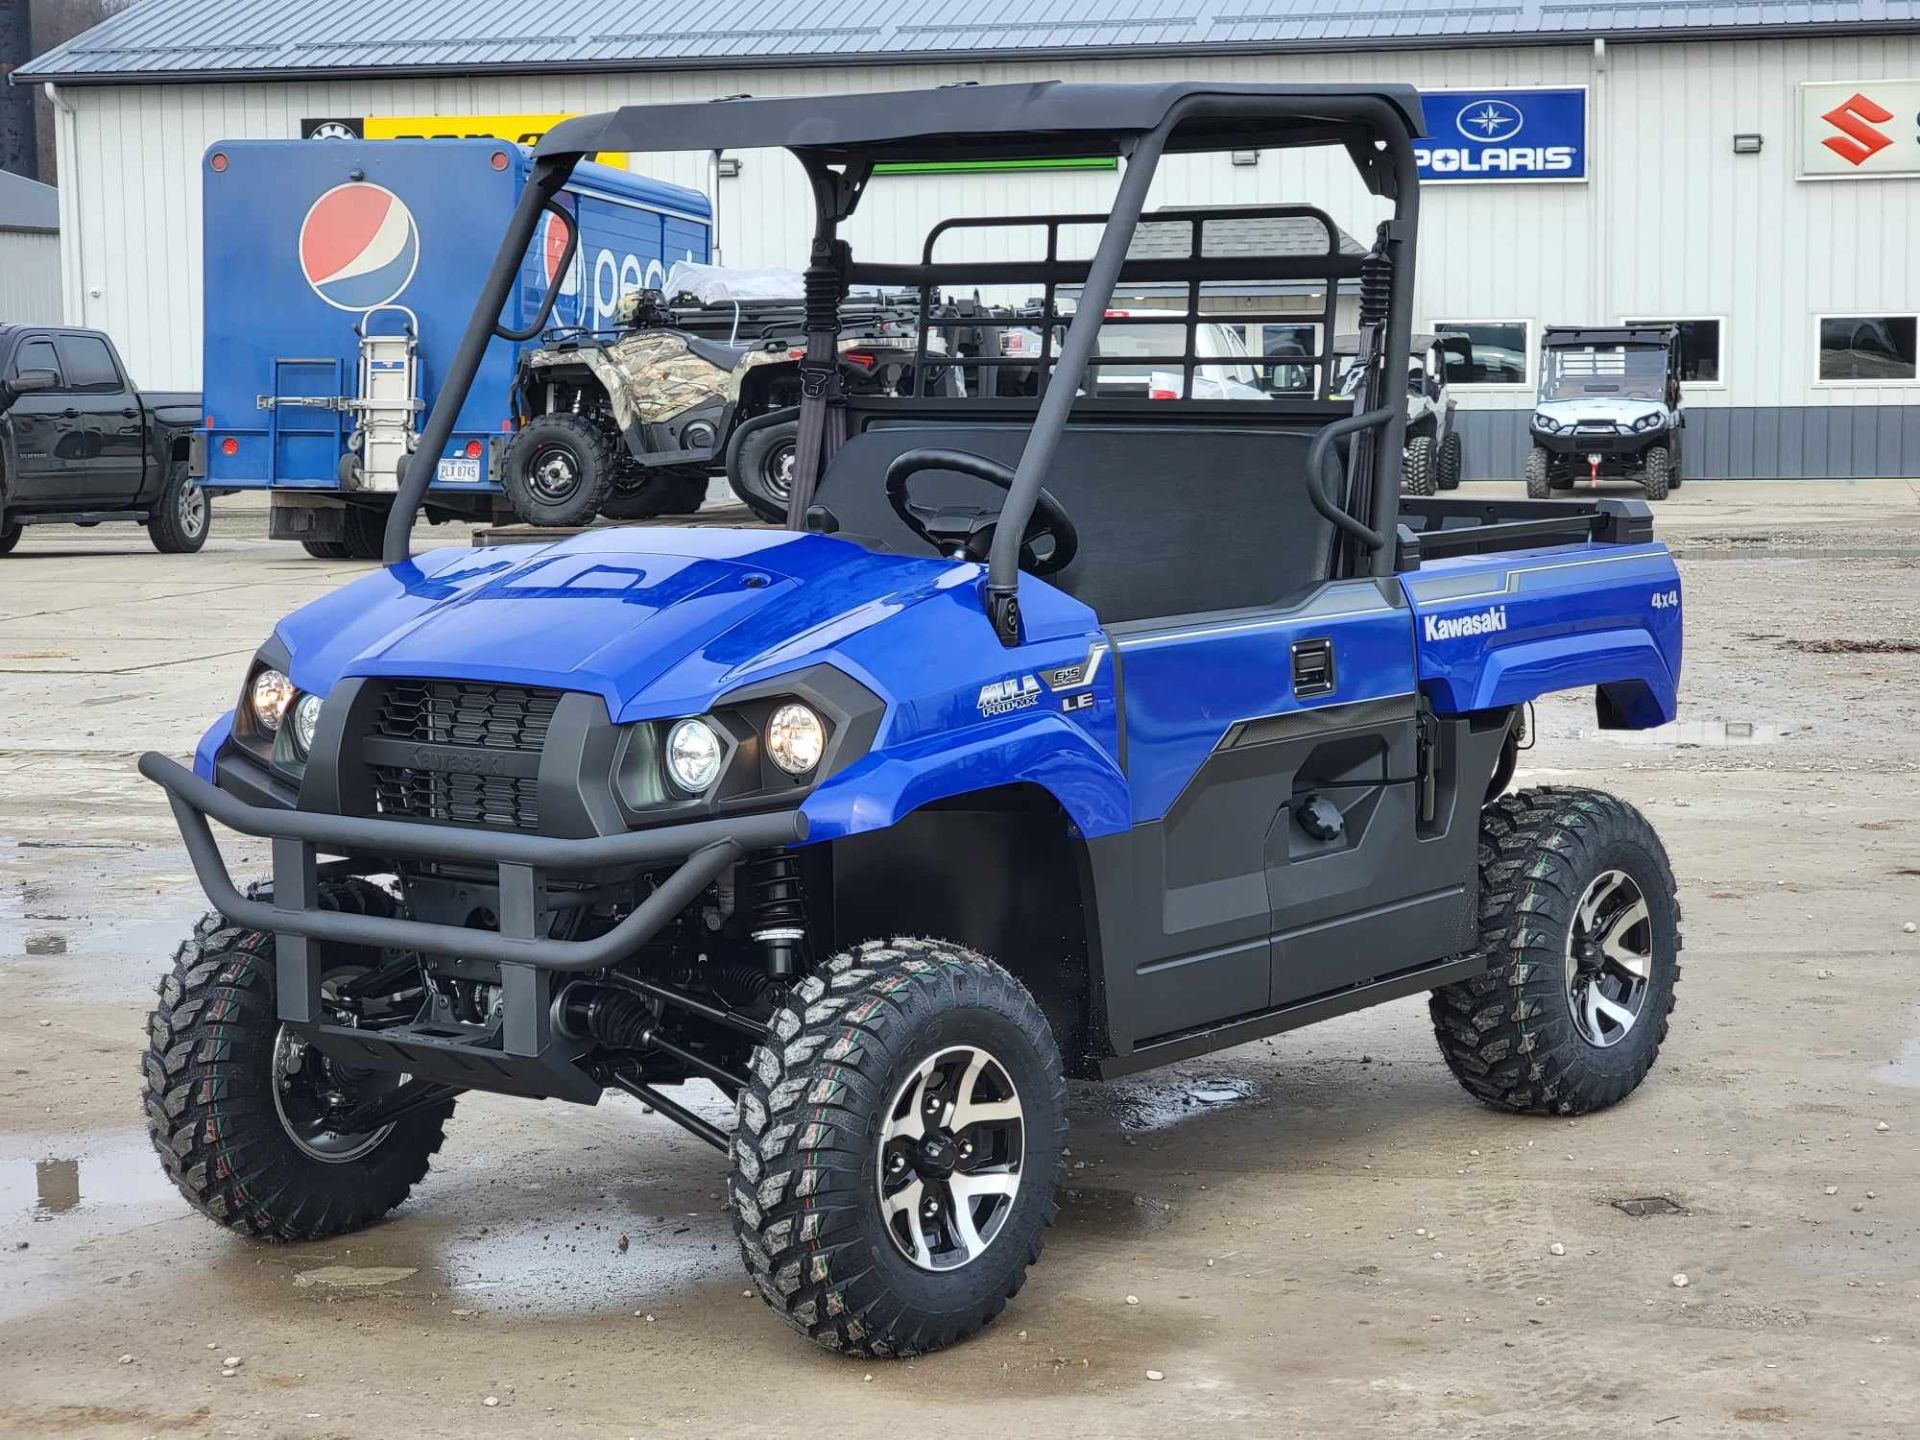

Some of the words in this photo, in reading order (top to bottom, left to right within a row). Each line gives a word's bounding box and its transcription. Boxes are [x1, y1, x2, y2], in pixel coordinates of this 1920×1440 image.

[1415, 147, 1573, 172] POLARIS
[1651, 590, 1679, 609] 4x4
[1424, 605, 1507, 642] Kawasaki
[1053, 667, 1080, 682] EPS
[1062, 693, 1093, 712] LE
